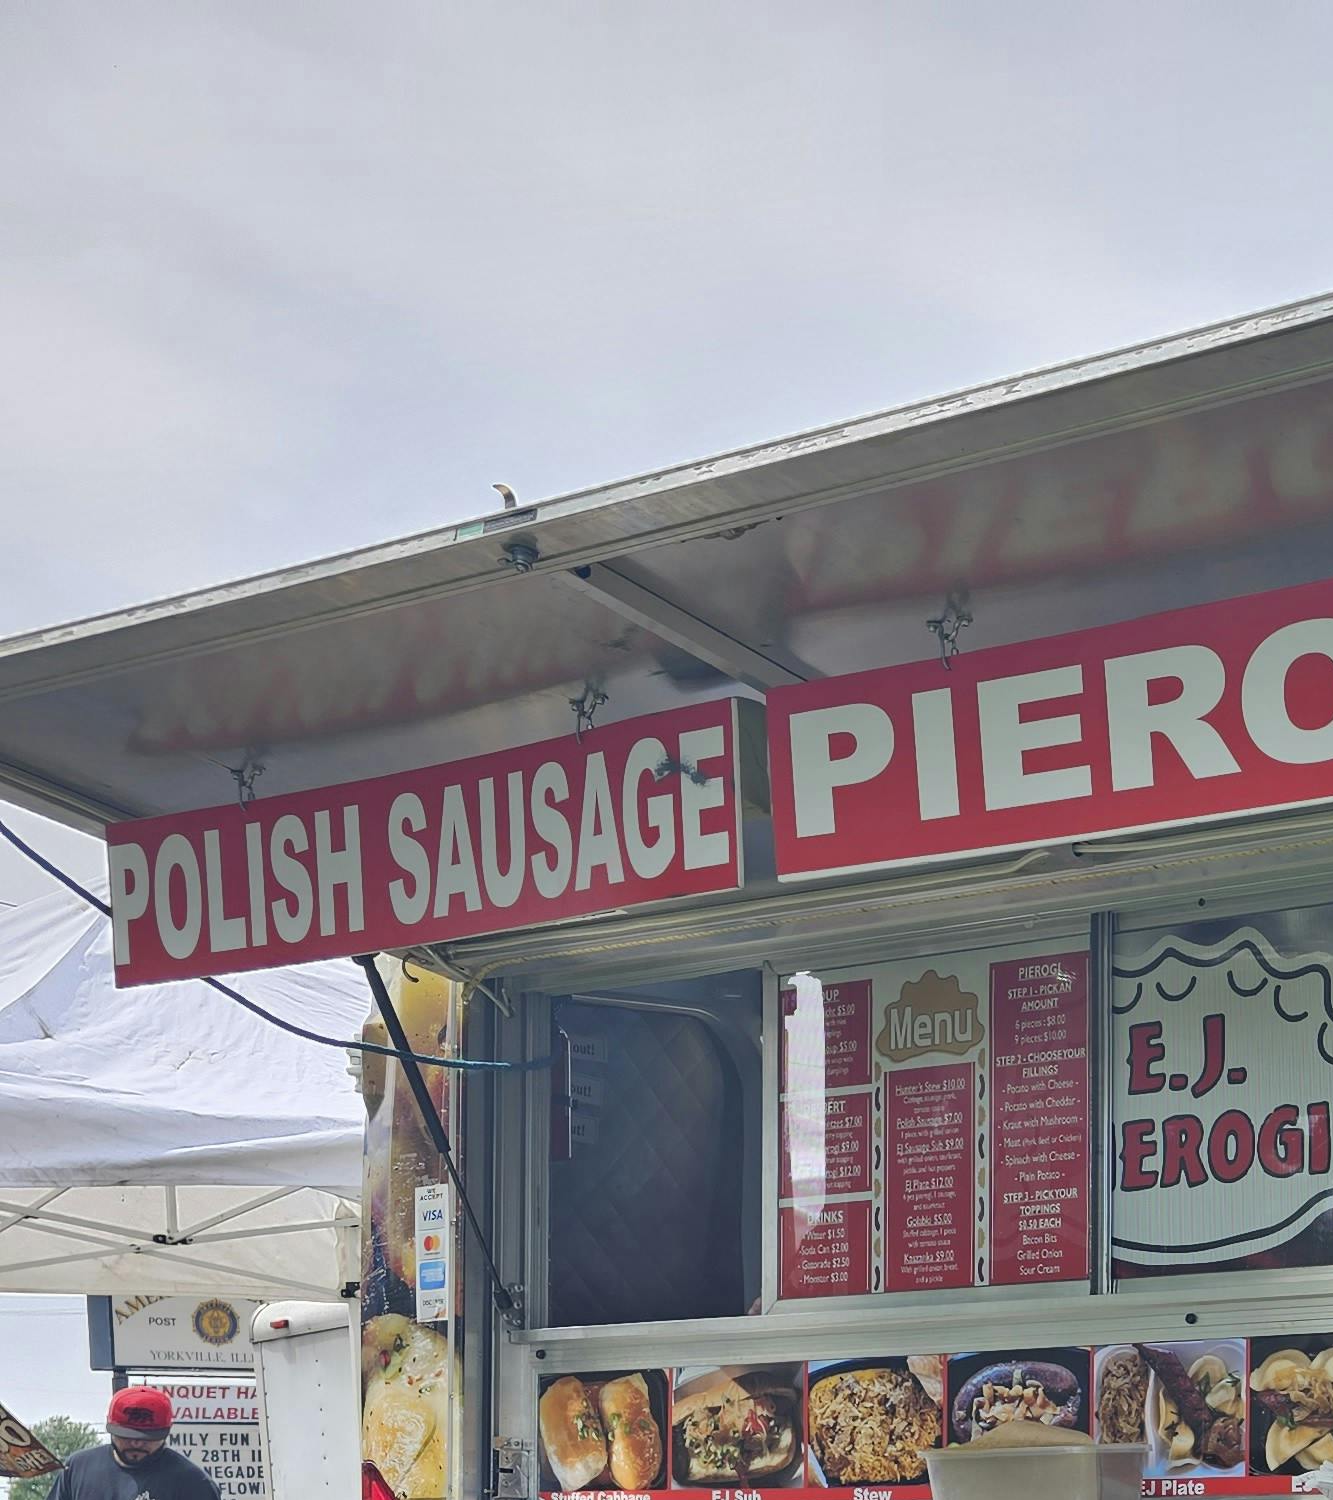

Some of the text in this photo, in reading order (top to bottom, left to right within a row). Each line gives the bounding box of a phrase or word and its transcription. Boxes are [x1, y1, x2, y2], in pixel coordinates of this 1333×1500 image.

[109, 725, 730, 966] POLISH SAUSAGE
[1021, 998, 1058, 1011] AMOUNT
[889, 1006, 973, 1050] Menu
[1127, 1013, 1248, 1098] E.J.
[1023, 1065, 1058, 1078] FILLINGS
[1114, 1101, 1331, 1193] EROGI
[423, 1209, 443, 1221] VISA
[1020, 1203, 1061, 1216] TOPPINGS
[148, 1317, 176, 1326] POST
[155, 1386, 230, 1399] NQUET
[173, 1407, 259, 1420] VAILABLE
[169, 1433, 249, 1446] MILY FUN
[201, 1450, 240, 1462] 28TH
[204, 1466, 264, 1479] NEGADE
[1162, 1479, 1205, 1496] Plate
